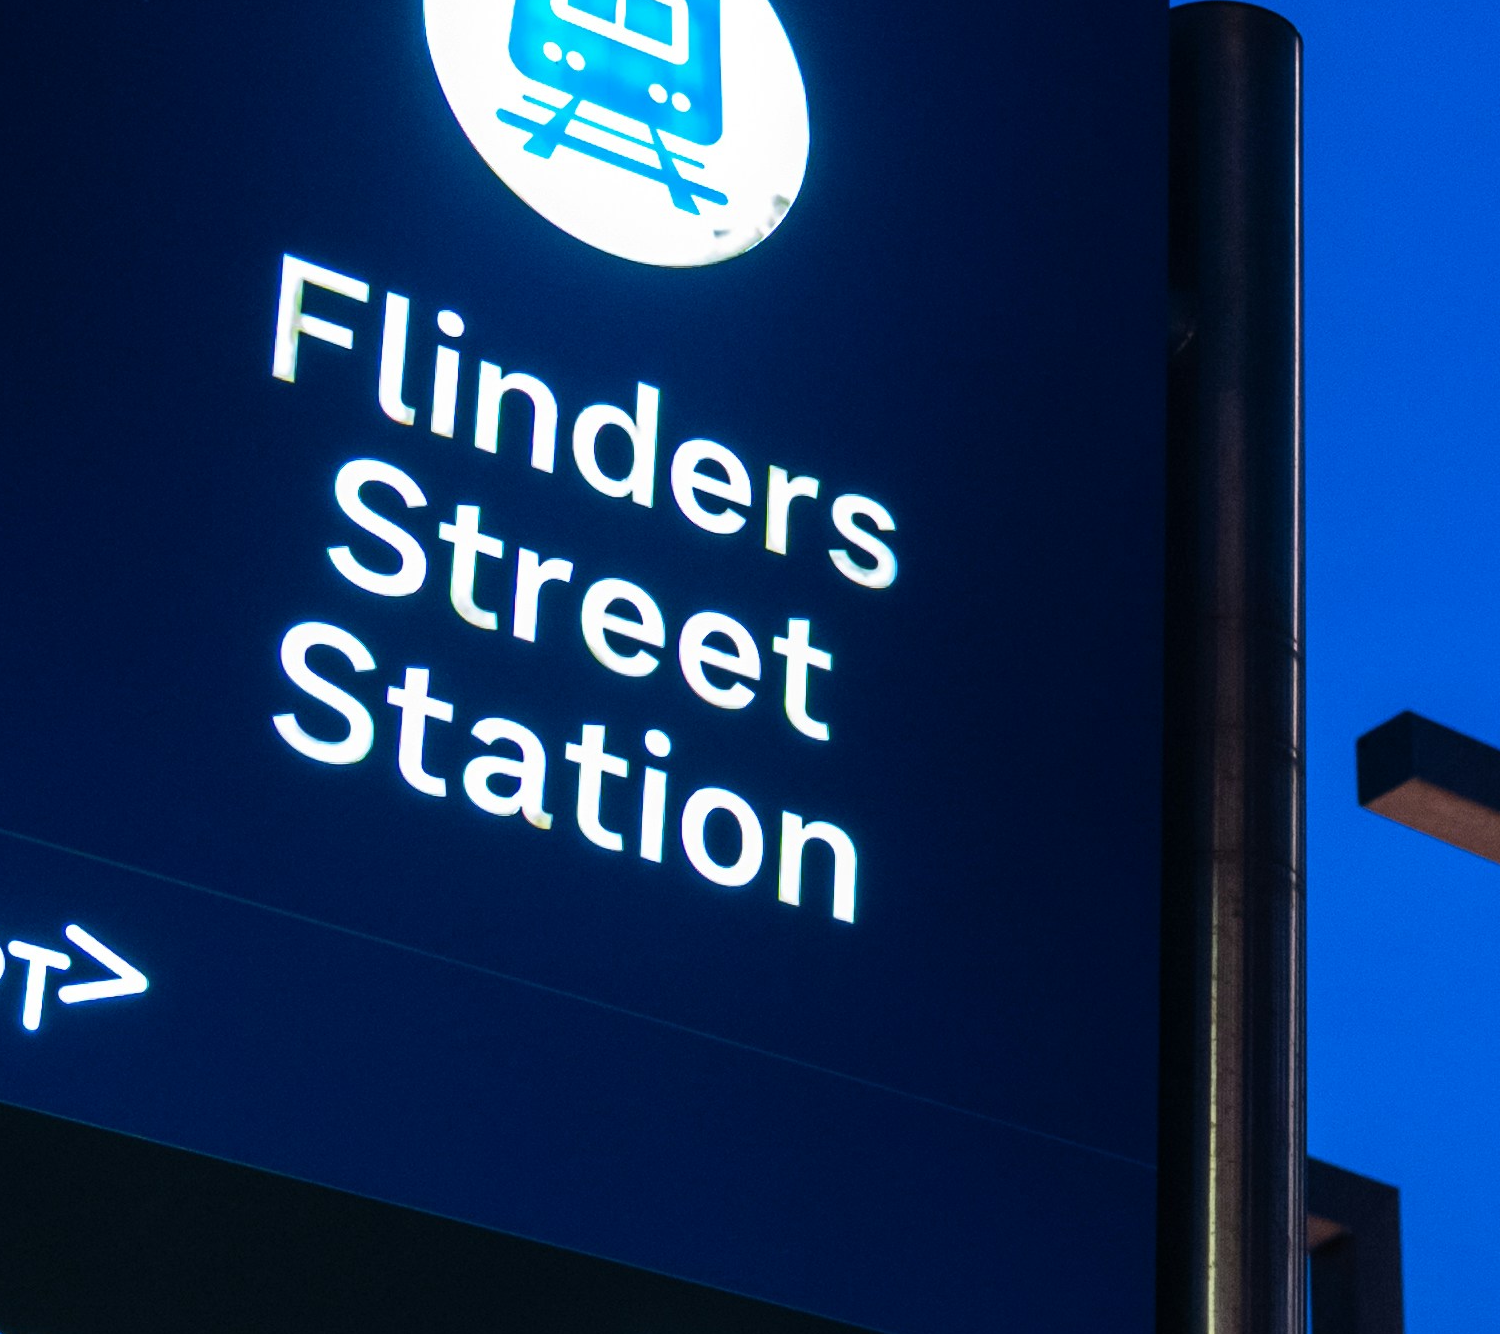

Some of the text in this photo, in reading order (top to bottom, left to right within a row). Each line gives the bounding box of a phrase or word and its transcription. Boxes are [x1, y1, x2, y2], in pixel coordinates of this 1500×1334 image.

[272, 252, 899, 590] Flinders
[326, 457, 833, 742] Street
[272, 621, 859, 925] Station
